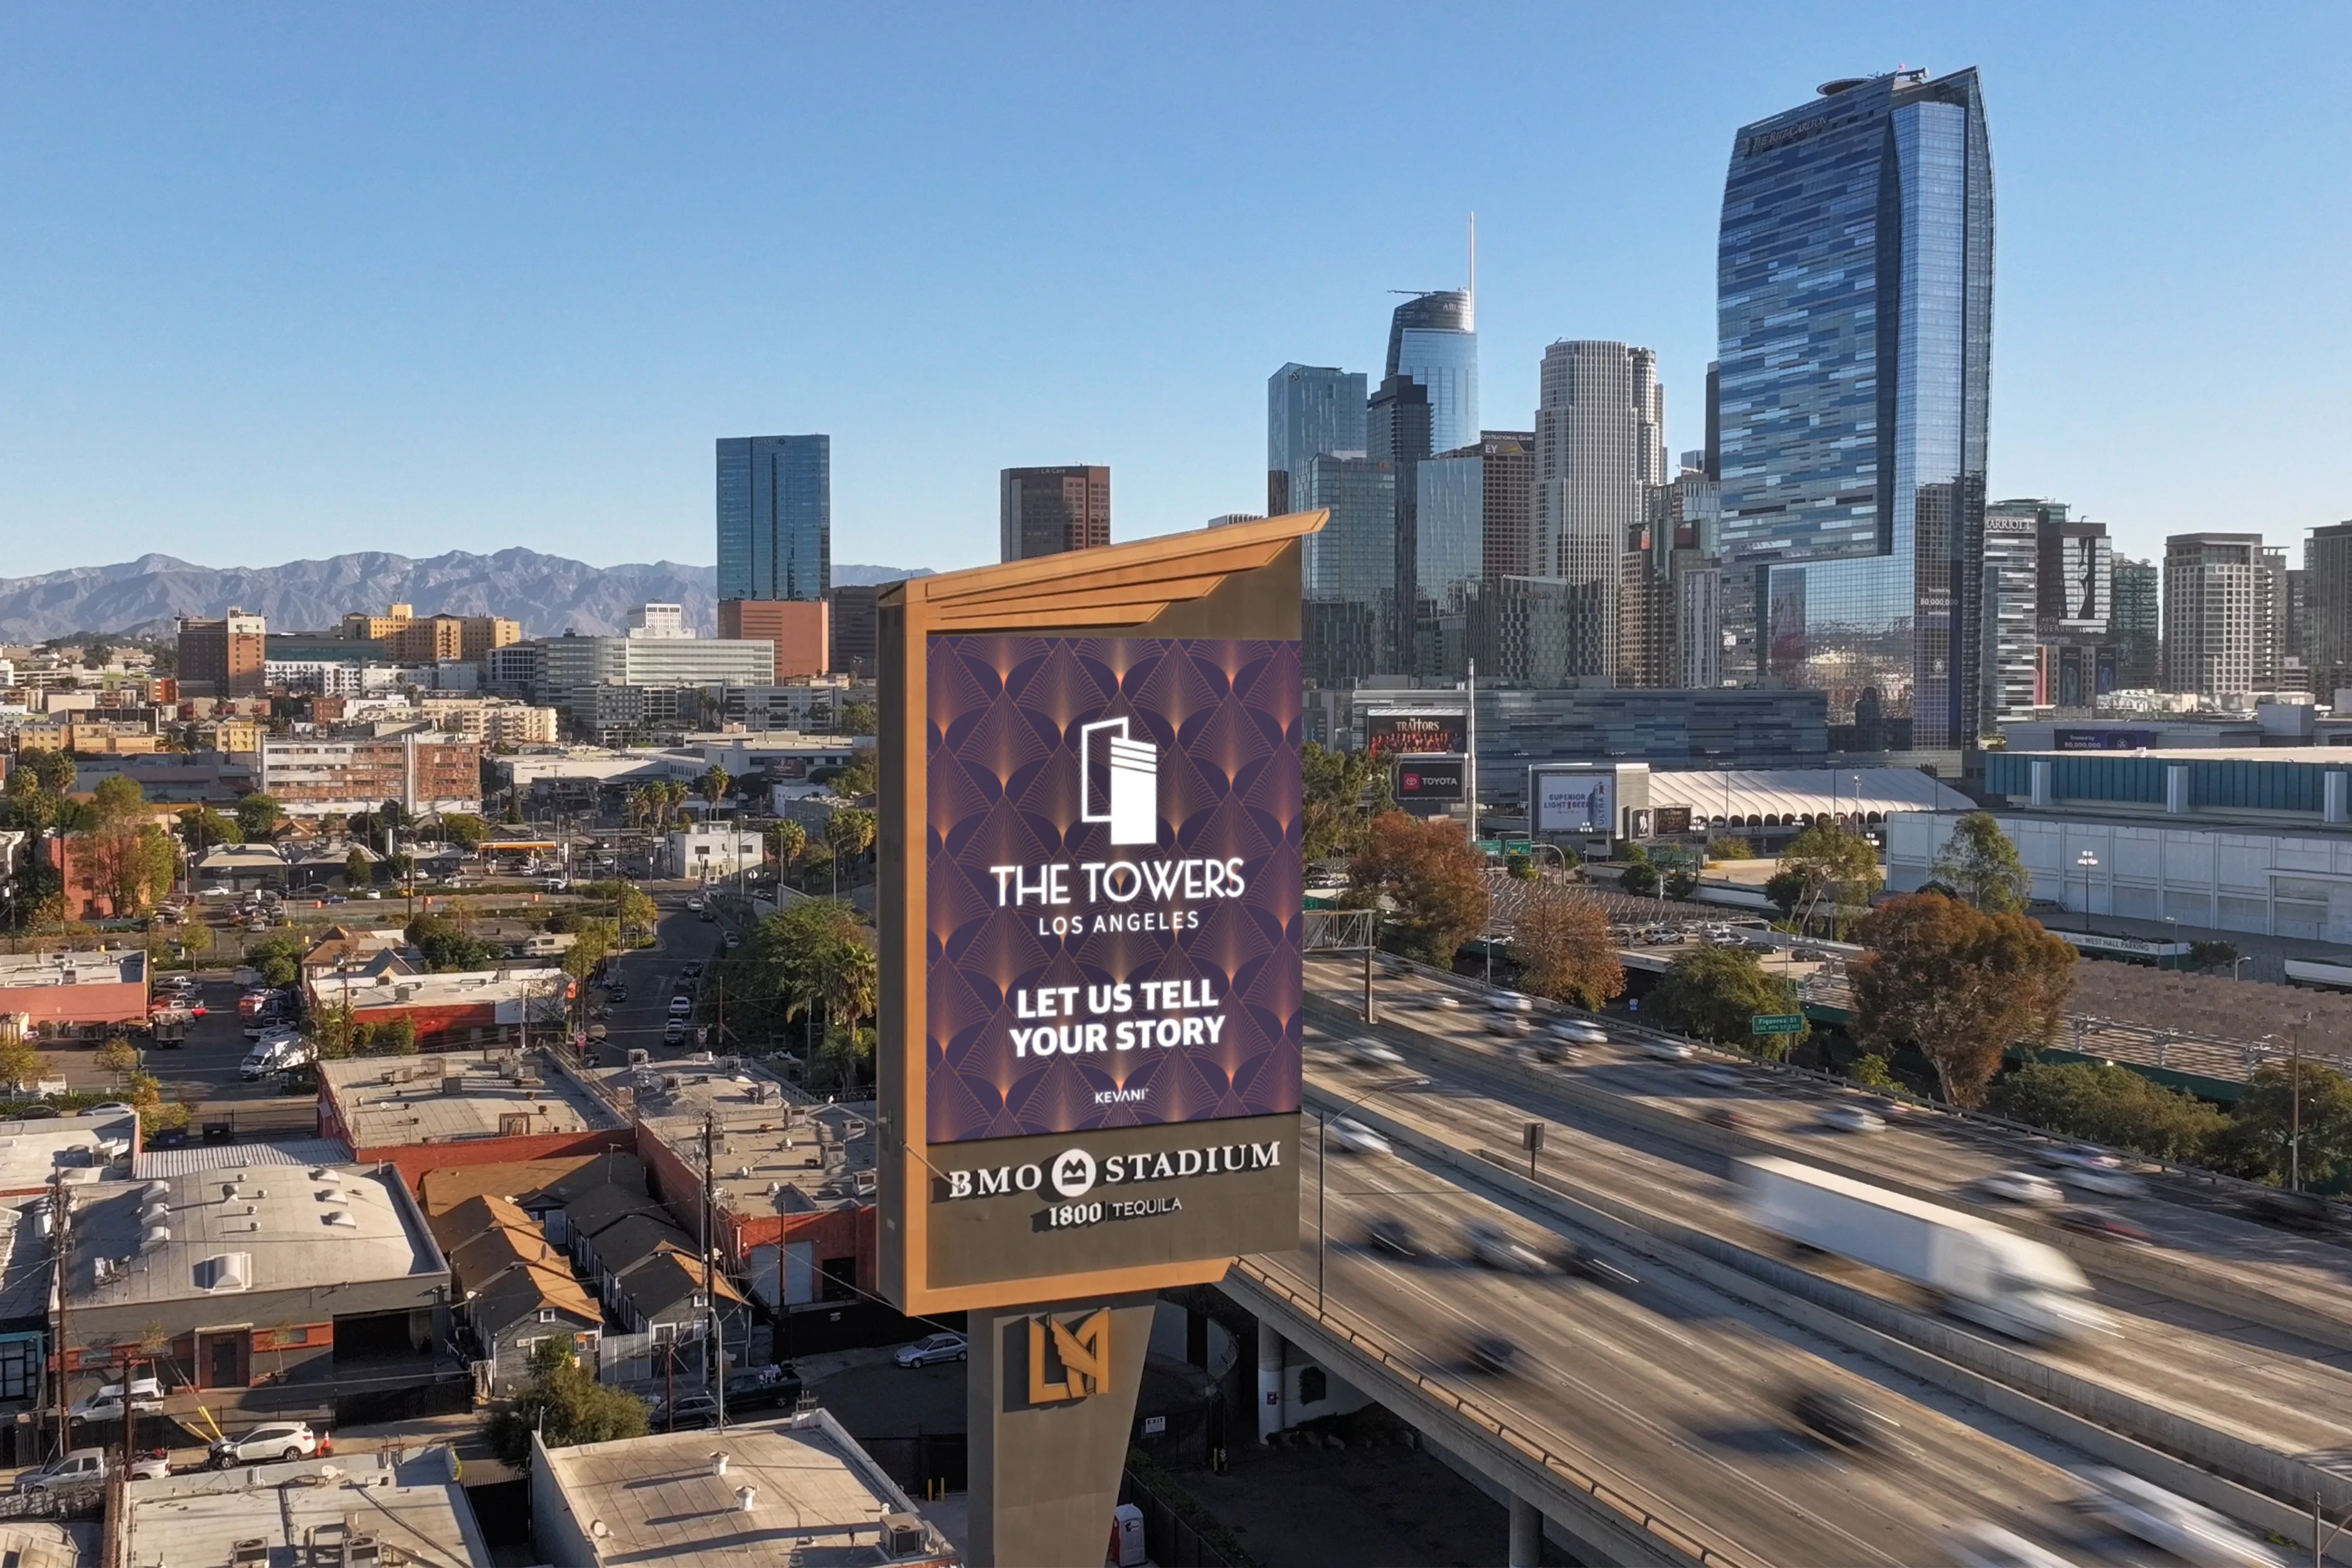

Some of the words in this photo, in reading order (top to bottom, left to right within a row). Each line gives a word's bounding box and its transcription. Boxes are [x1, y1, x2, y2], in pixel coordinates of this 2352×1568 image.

[1485, 444, 1498, 453] EY
[1396, 718, 1439, 733] TRAITORS
[990, 864, 1071, 906] THE
[1081, 857, 1245, 903] TOWERS
[1039, 915, 1083, 936] LOS
[1093, 911, 1199, 933] ANGELES
[2085, 937, 2101, 945] WEST
[2102, 939, 2119, 948] HALL
[2121, 941, 2149, 951] PARKING
[1017, 987, 1079, 1019] LET
[1088, 983, 1132, 1014] US
[1140, 979, 1219, 1010] TELL
[1009, 1024, 1108, 1057] YOUR
[1116, 1015, 1226, 1051] STORY
[1095, 1089, 1146, 1104] KEVANI
[949, 1164, 1042, 1197] BMO
[1105, 1141, 1281, 1182] STADIUM
[1049, 1202, 1101, 1226] 1800
[1113, 1197, 1182, 1217] TEQUILA
